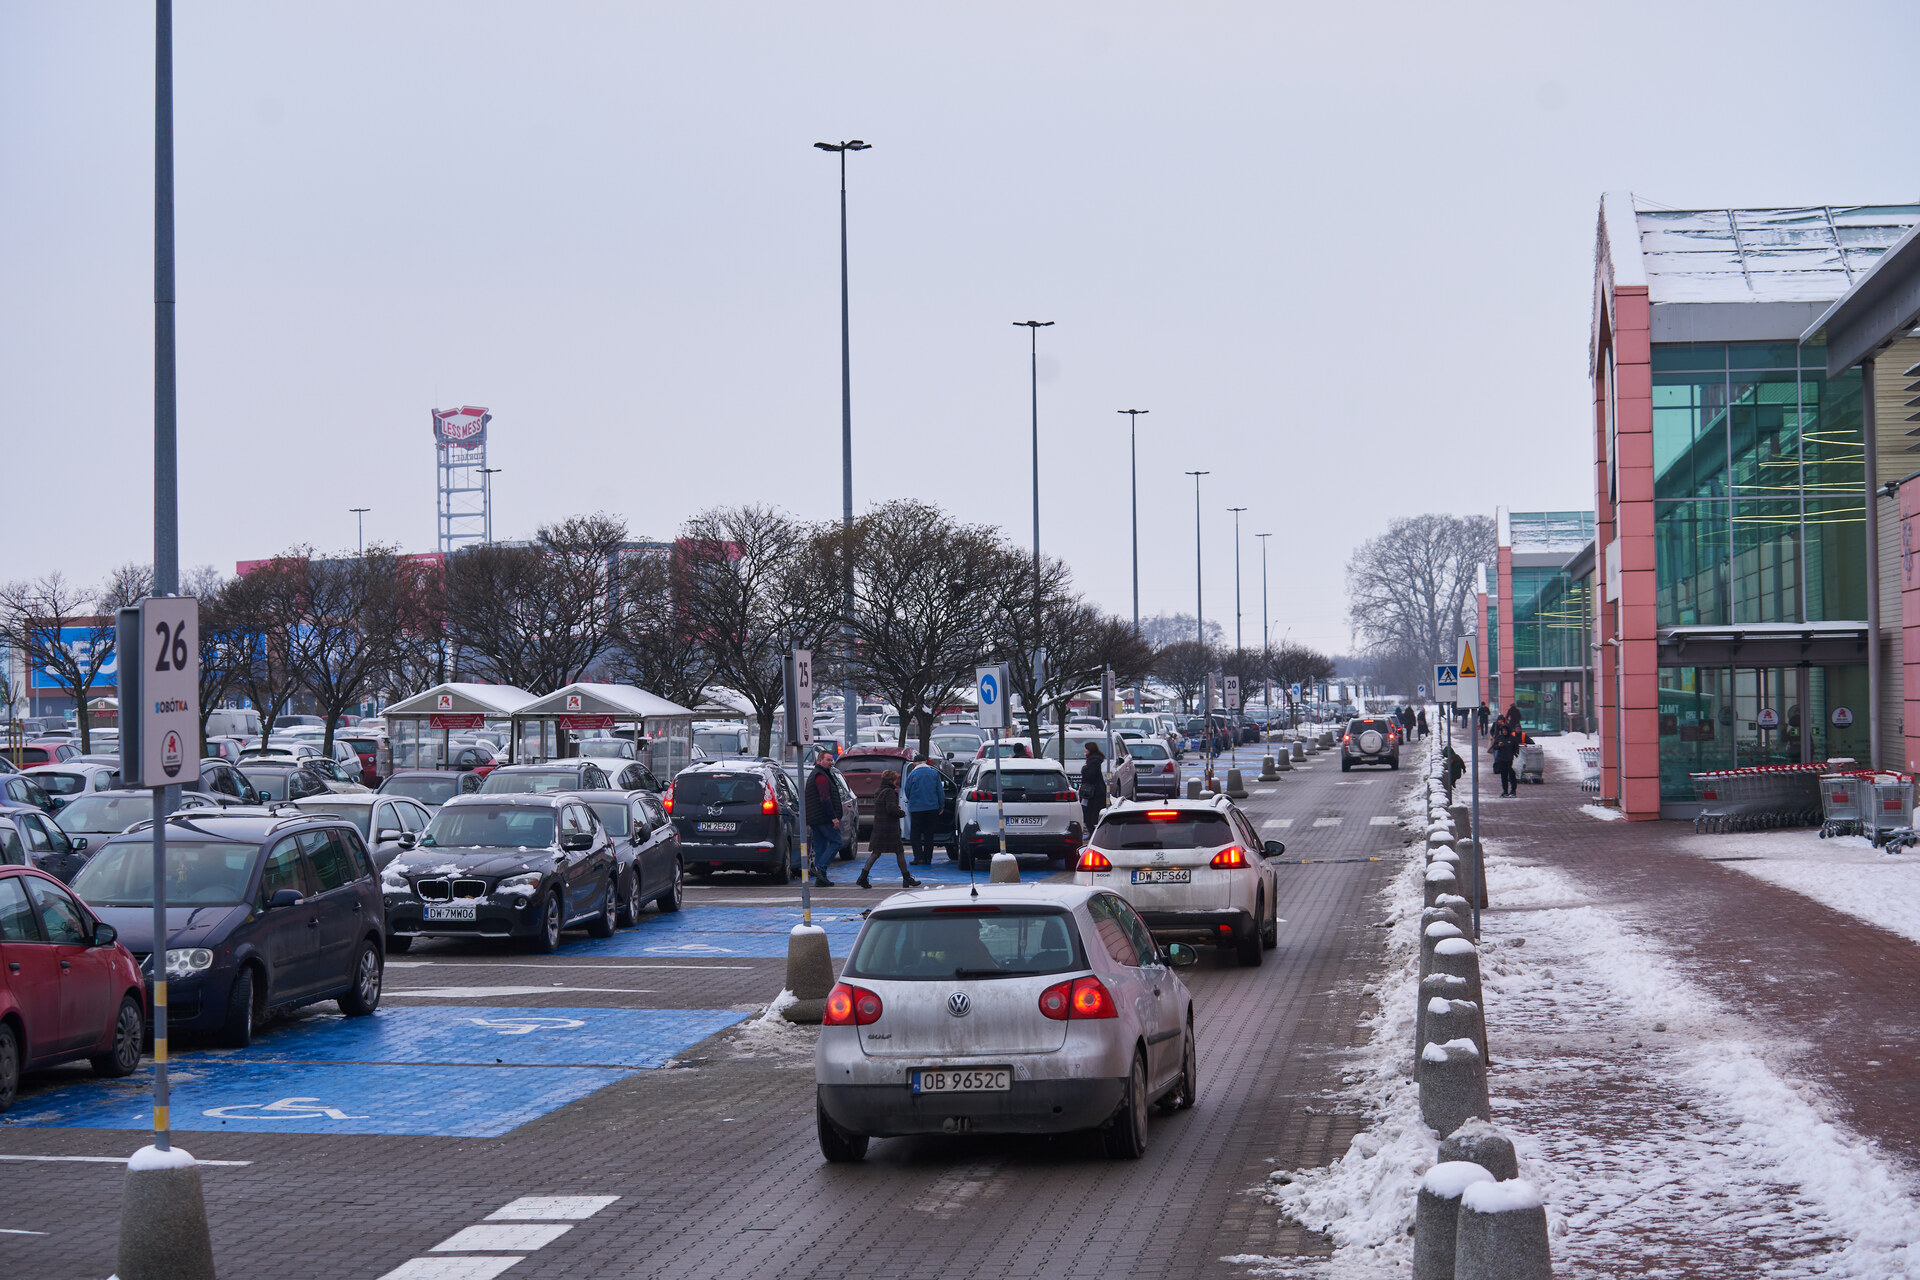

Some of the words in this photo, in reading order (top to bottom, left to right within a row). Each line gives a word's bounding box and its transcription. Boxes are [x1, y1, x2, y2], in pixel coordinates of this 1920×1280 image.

[443, 420, 461, 438] LESS
[462, 418, 481, 438] MESS
[155, 620, 188, 672] 26
[799, 661, 809, 688] 25
[1227, 680, 1237, 690] 20
[155, 697, 188, 714] SOBÓTKA
[1010, 817, 1019, 825] DW
[1020, 816, 1041, 825] 6AS57
[1138, 871, 1152, 881] DW
[1155, 871, 1188, 881] 3FS66
[430, 908, 442, 918] DW
[445, 908, 474, 919] 7MW06
[924, 1073, 946, 1090] OB
[952, 1072, 1006, 1089] 9652C
